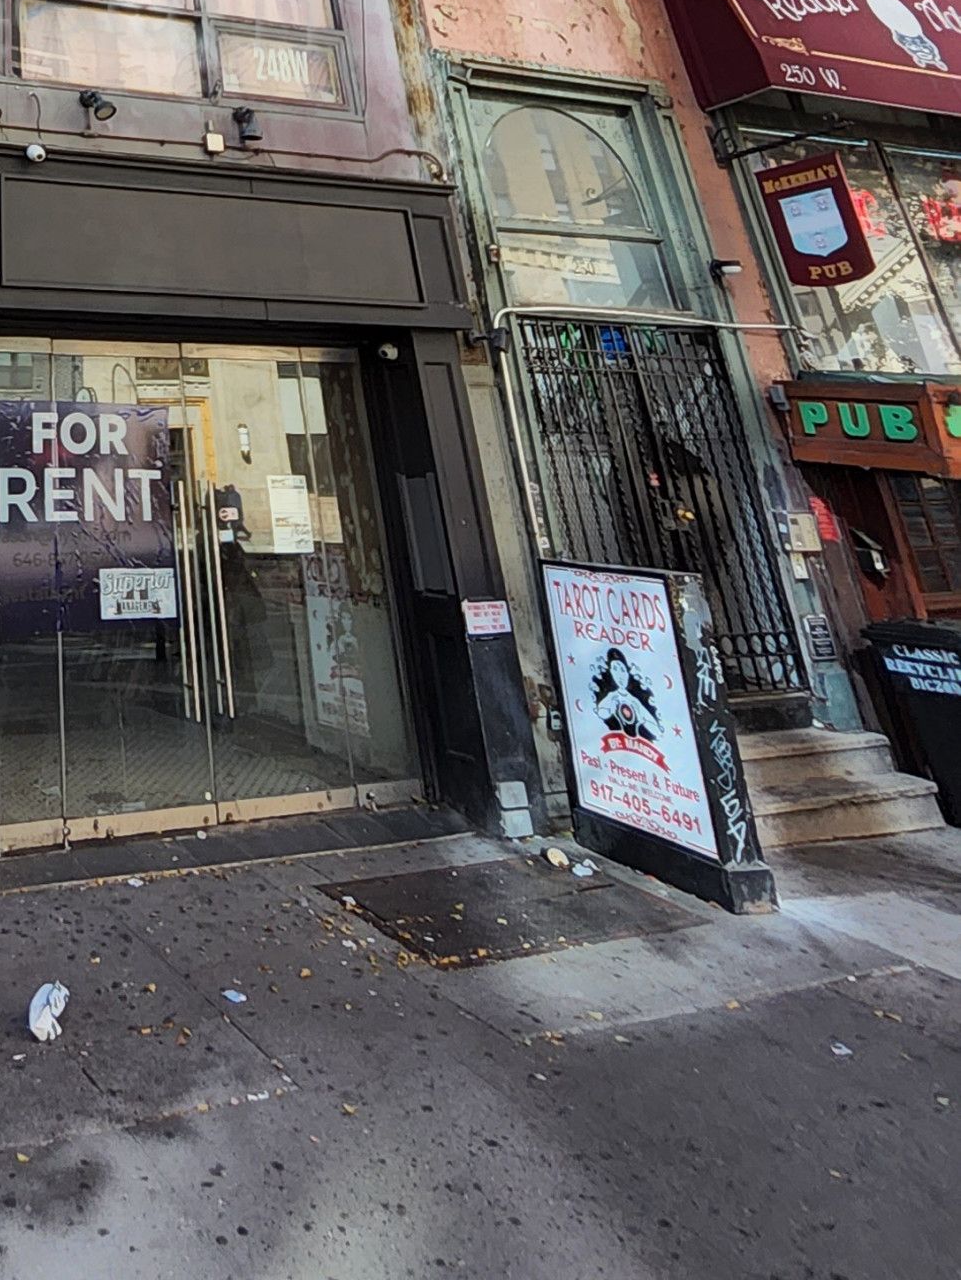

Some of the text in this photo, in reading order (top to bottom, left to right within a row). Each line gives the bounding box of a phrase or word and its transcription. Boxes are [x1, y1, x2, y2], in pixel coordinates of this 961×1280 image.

[780, 63, 815, 86] 250
[808, 261, 853, 280] PUB
[31, 412, 129, 455] FOR
[797, 401, 919, 441] PUB
[102, 572, 175, 598] Superior
[552, 580, 603, 620] TAROT
[606, 588, 666, 633] CARDS
[574, 620, 654, 652] READER
[892, 644, 960, 665] CLASSIC
[581, 750, 603, 770] Past
[609, 759, 649, 786] Present
[664, 777, 700, 802] Future
[590, 780, 703, 835] 917-405-6491
